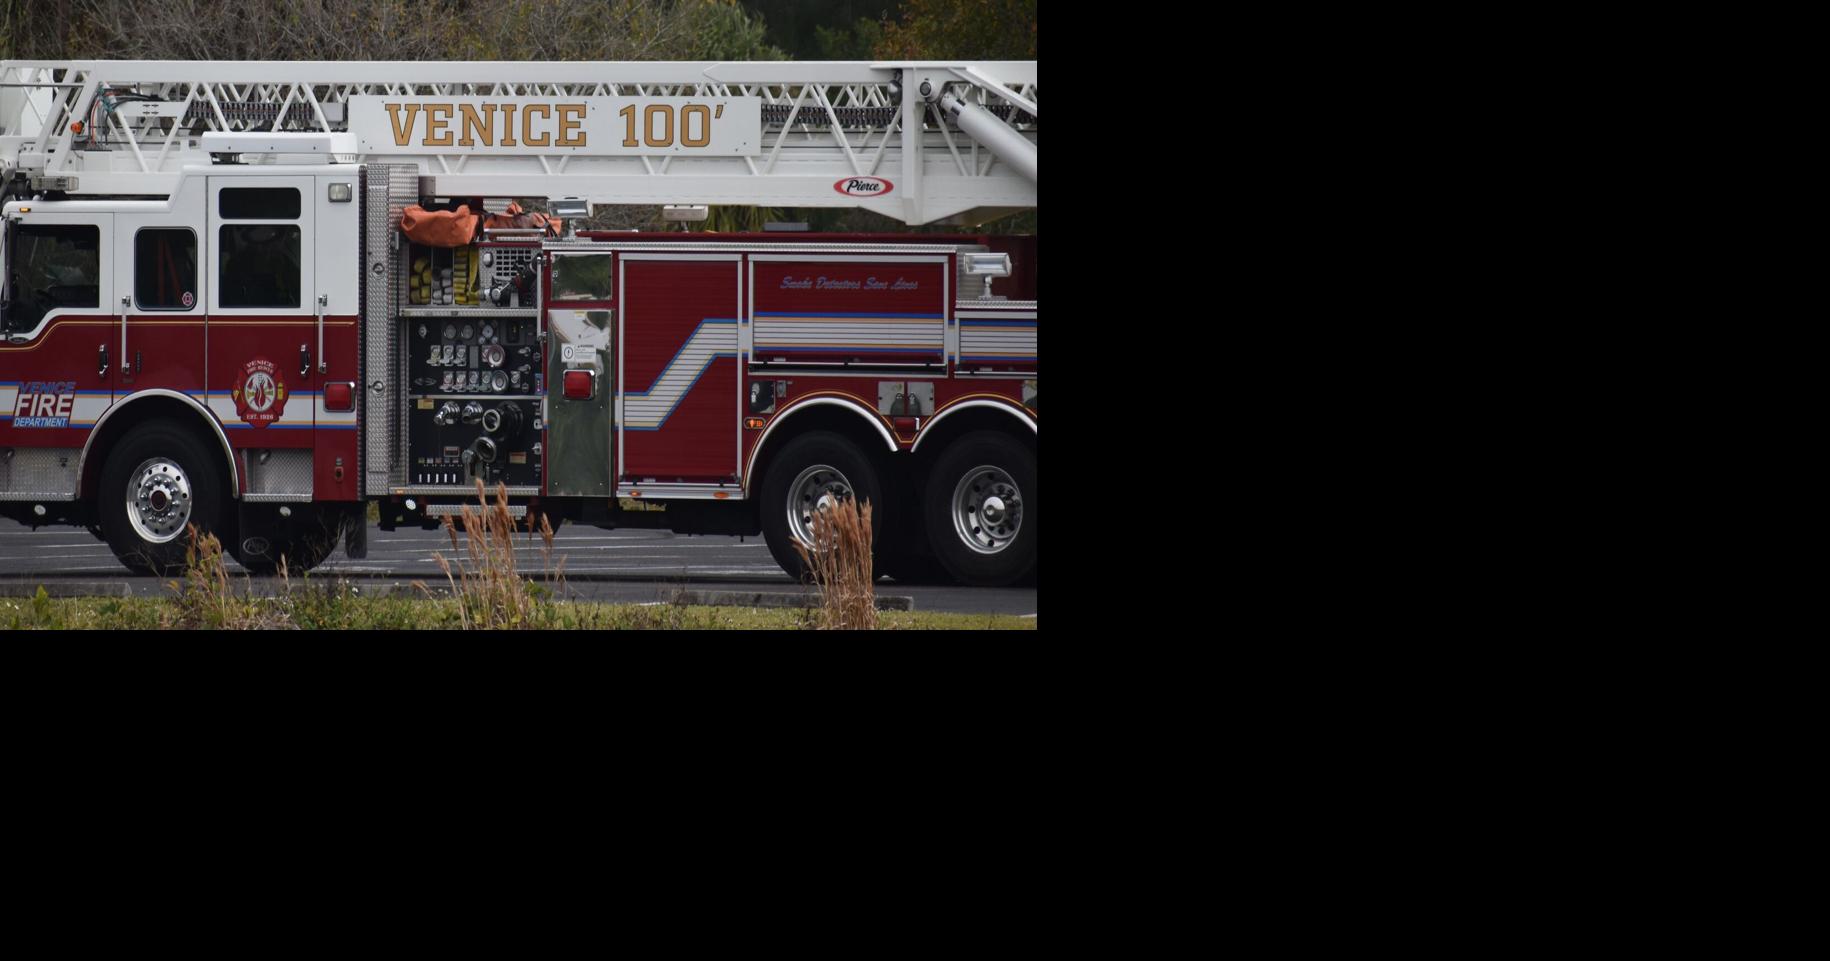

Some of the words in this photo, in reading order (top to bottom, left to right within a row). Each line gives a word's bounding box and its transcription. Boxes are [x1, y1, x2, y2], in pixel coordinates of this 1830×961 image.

[384, 103, 587, 147] VENICE
[619, 103, 724, 148] 100'
[846, 179, 880, 193] Pierce
[246, 360, 274, 369] VENICE
[18, 381, 76, 395] VENICE
[14, 394, 74, 417] FIRE
[14, 417, 67, 427] DEPARTMENT
